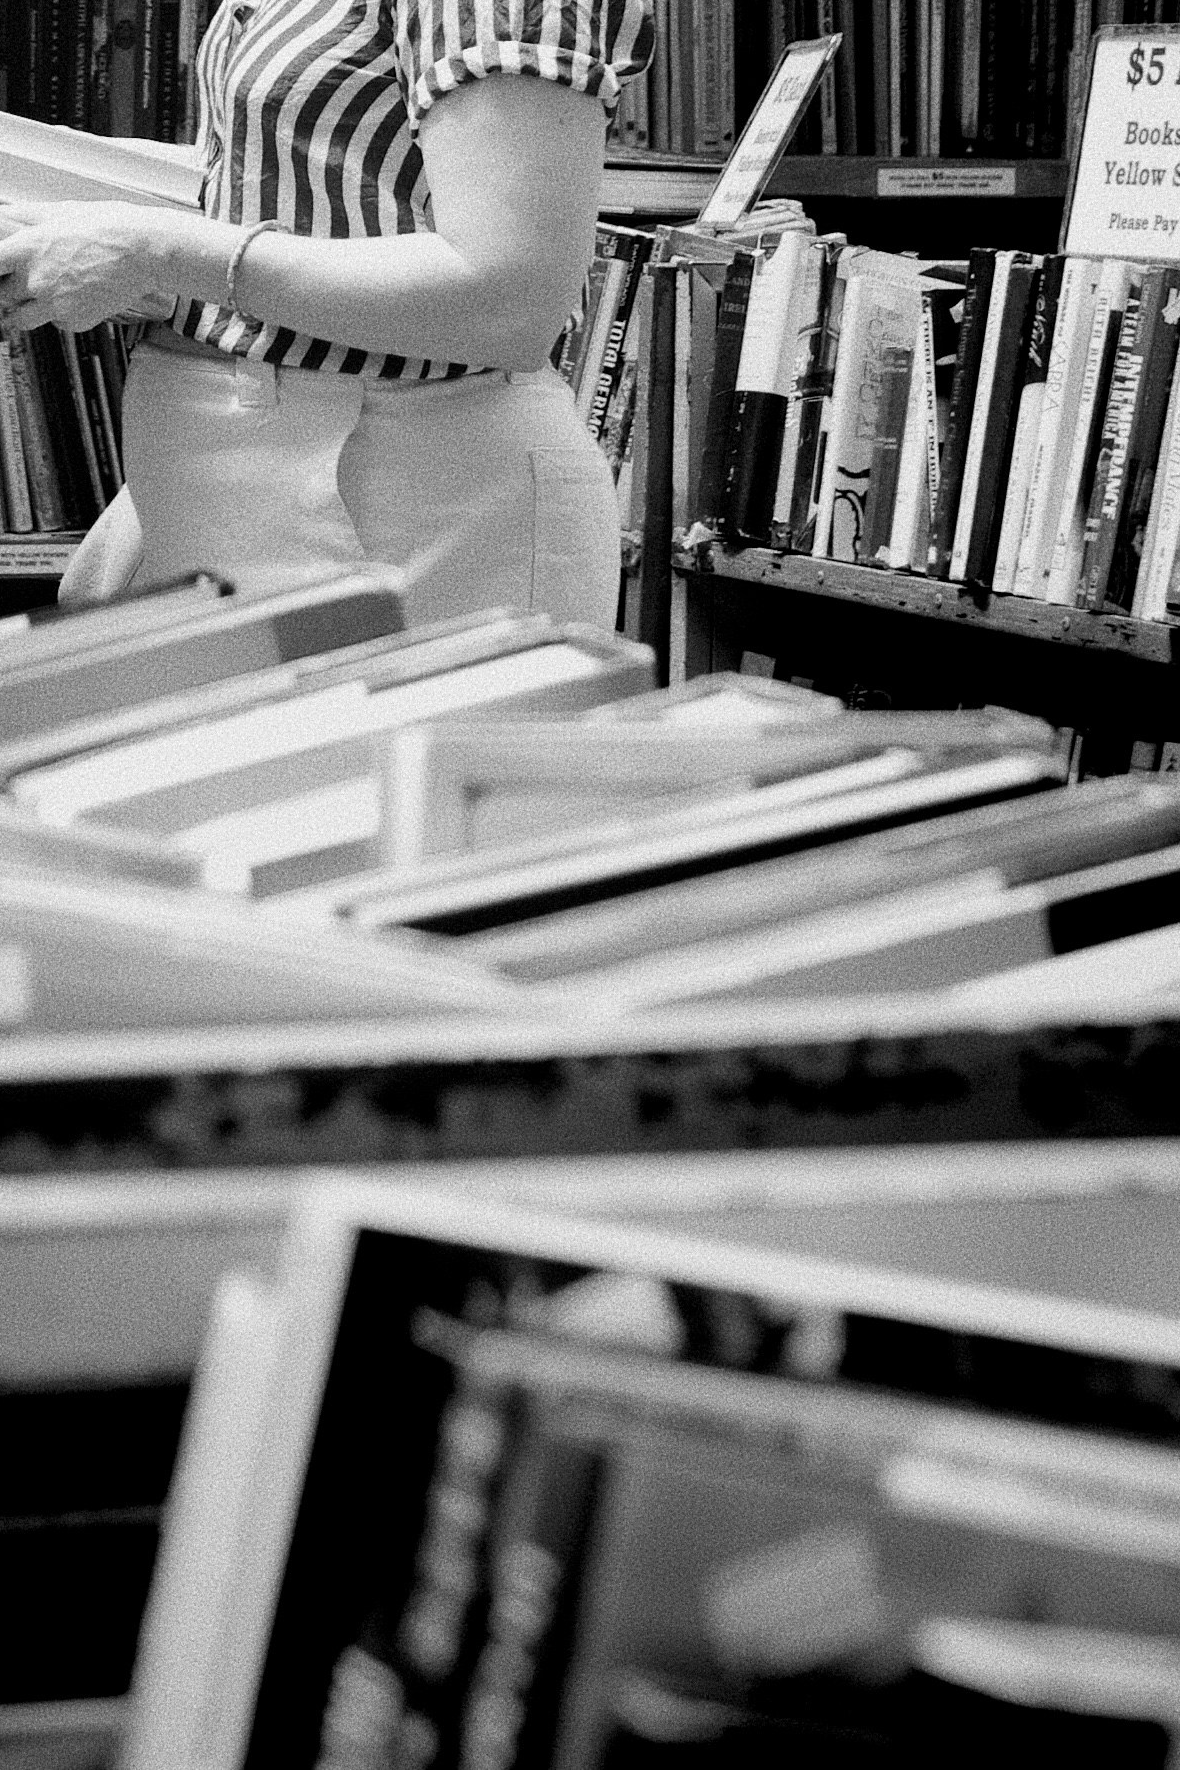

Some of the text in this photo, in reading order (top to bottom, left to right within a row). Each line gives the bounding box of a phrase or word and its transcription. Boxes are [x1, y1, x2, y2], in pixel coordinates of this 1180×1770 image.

[1126, 42, 1166, 91] $5
[1124, 120, 1180, 146] Books
[1104, 160, 1167, 186] Yellow
[1108, 212, 1180, 239] Please Pay
[1090, 295, 1109, 339] RUTH
[1126, 297, 1142, 310] A
[601, 316, 627, 368] TOTAL
[1119, 311, 1139, 349] TEAM
[1113, 350, 1133, 378] FOR
[926, 388, 934, 410] AN
[1101, 379, 1128, 441] AMERICA
[927, 436, 936, 451] IN
